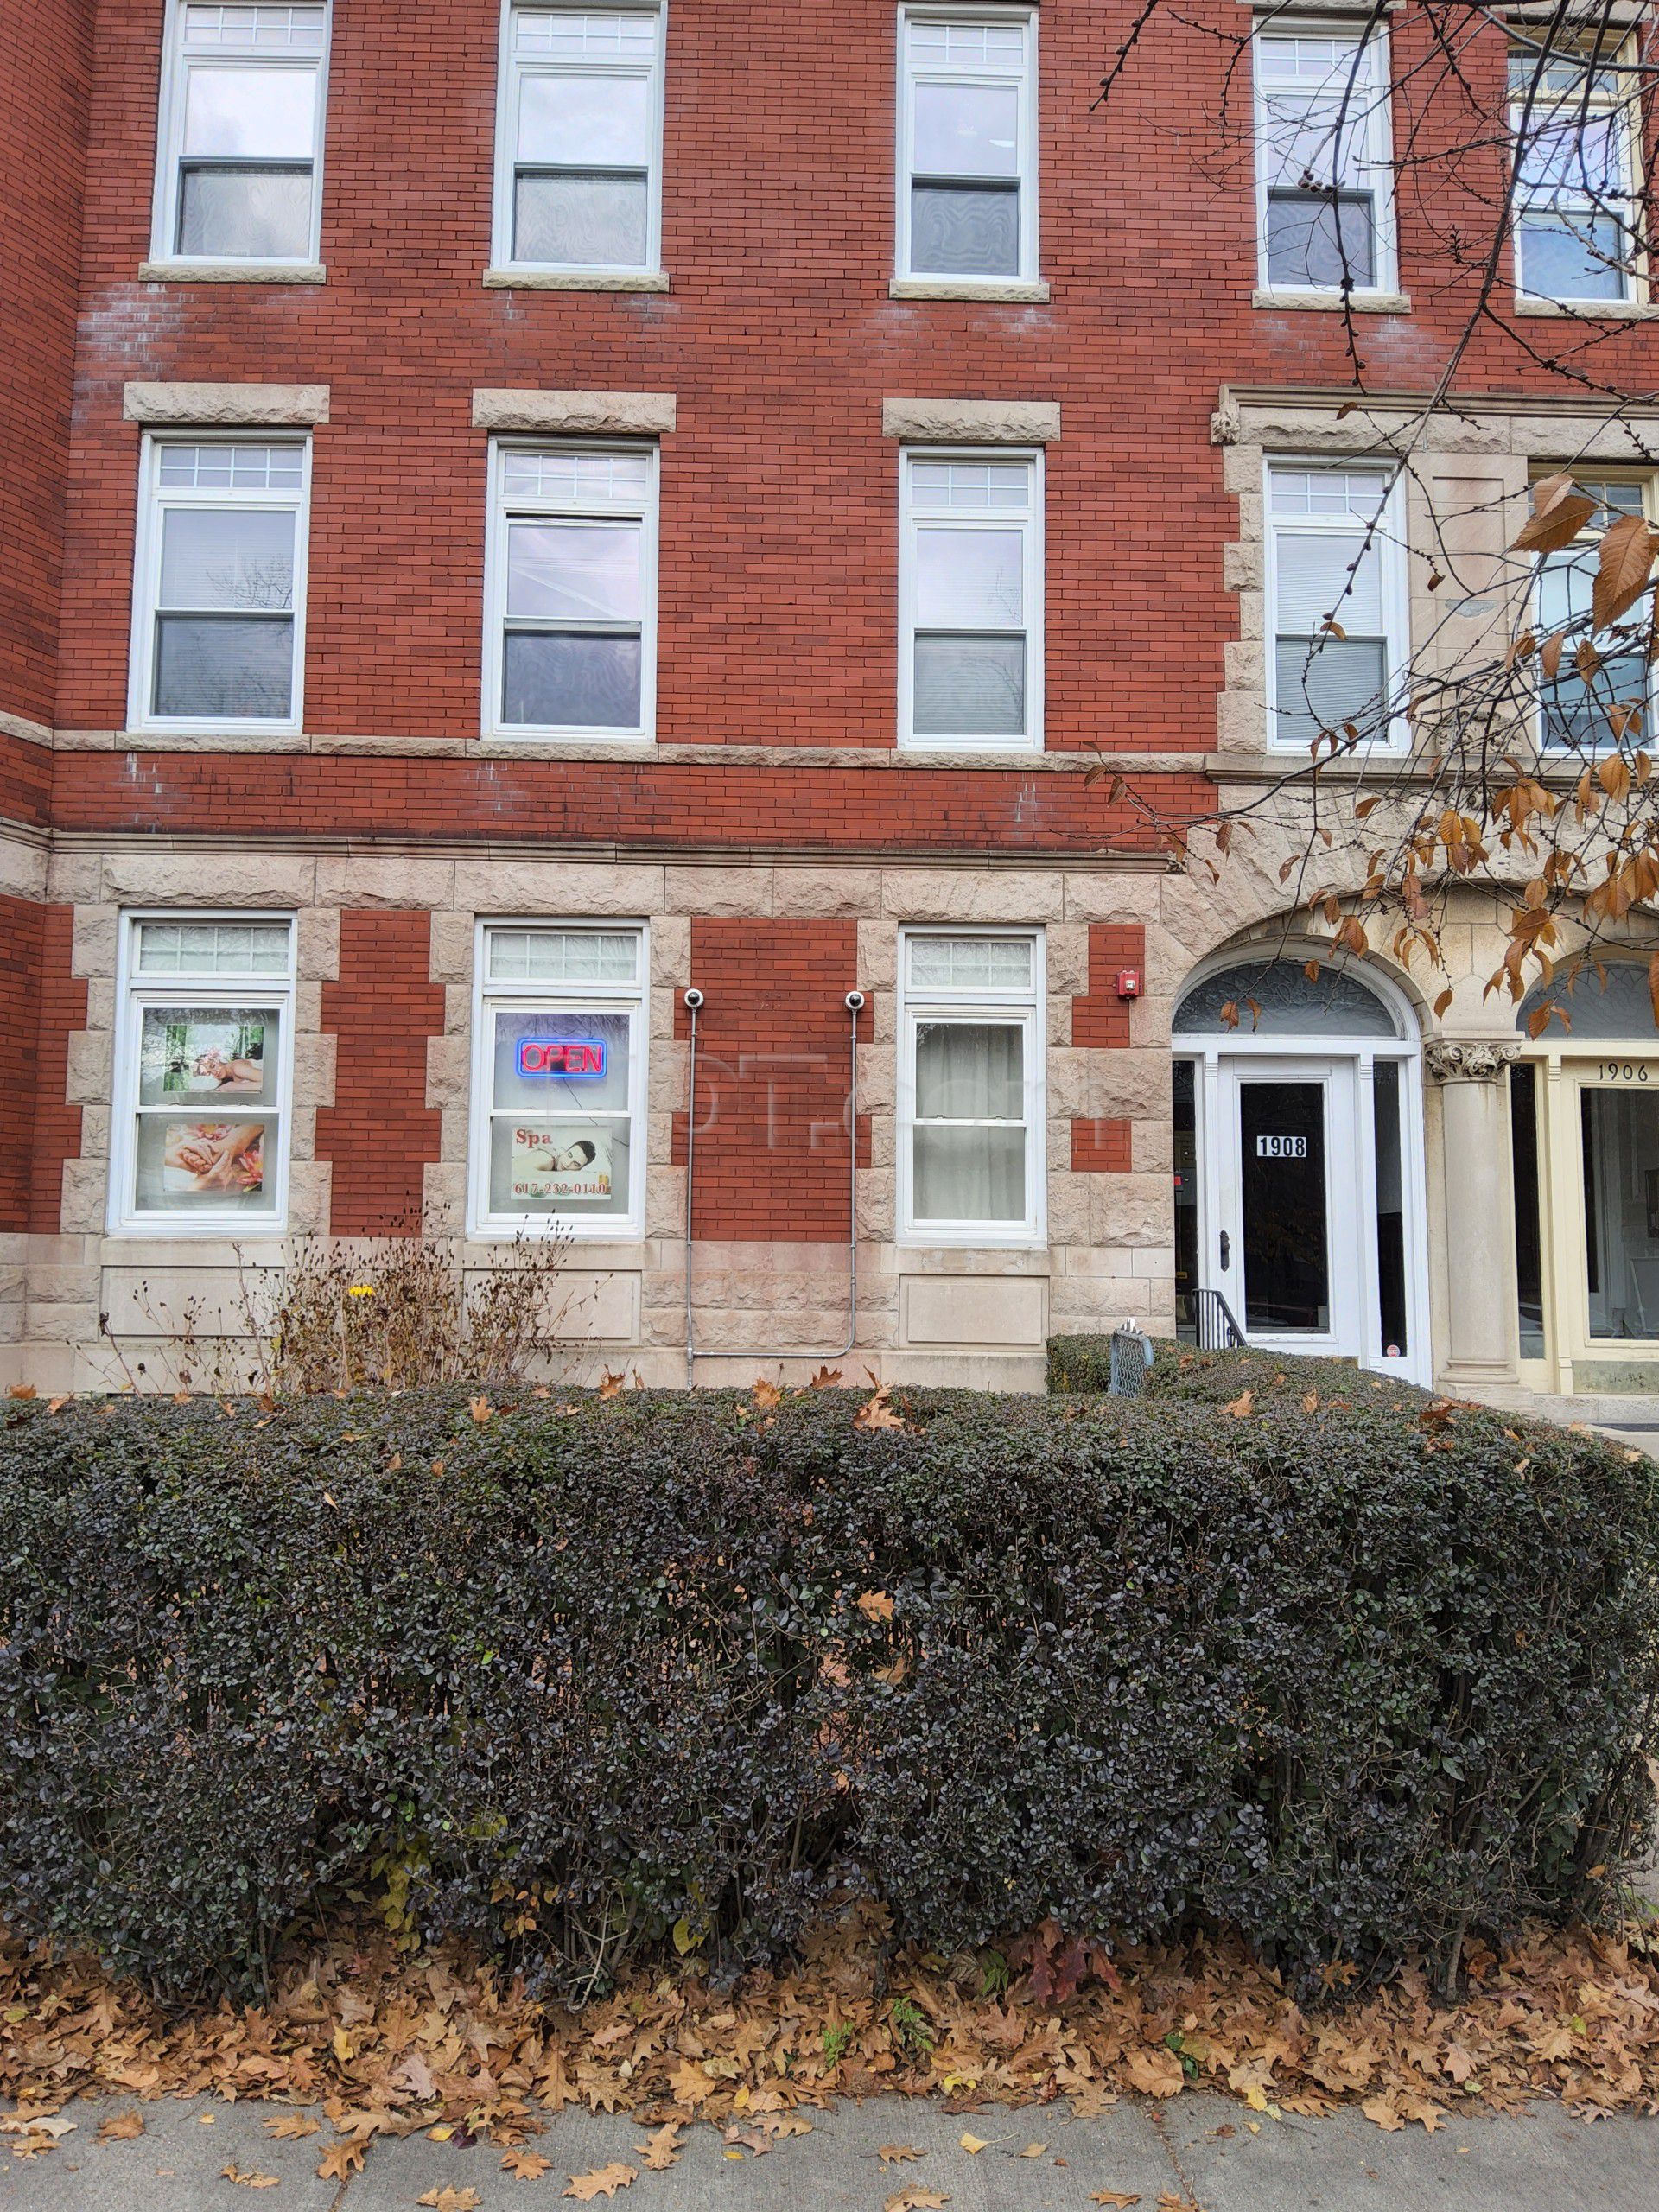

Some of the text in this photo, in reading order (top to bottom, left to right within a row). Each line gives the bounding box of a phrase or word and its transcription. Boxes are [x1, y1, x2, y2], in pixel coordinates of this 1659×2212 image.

[522, 1044, 602, 1071] OPEN
[1599, 1063, 1648, 1081] 1906
[516, 1128, 552, 1148] Spa
[1260, 1136, 1306, 1156] 1908
